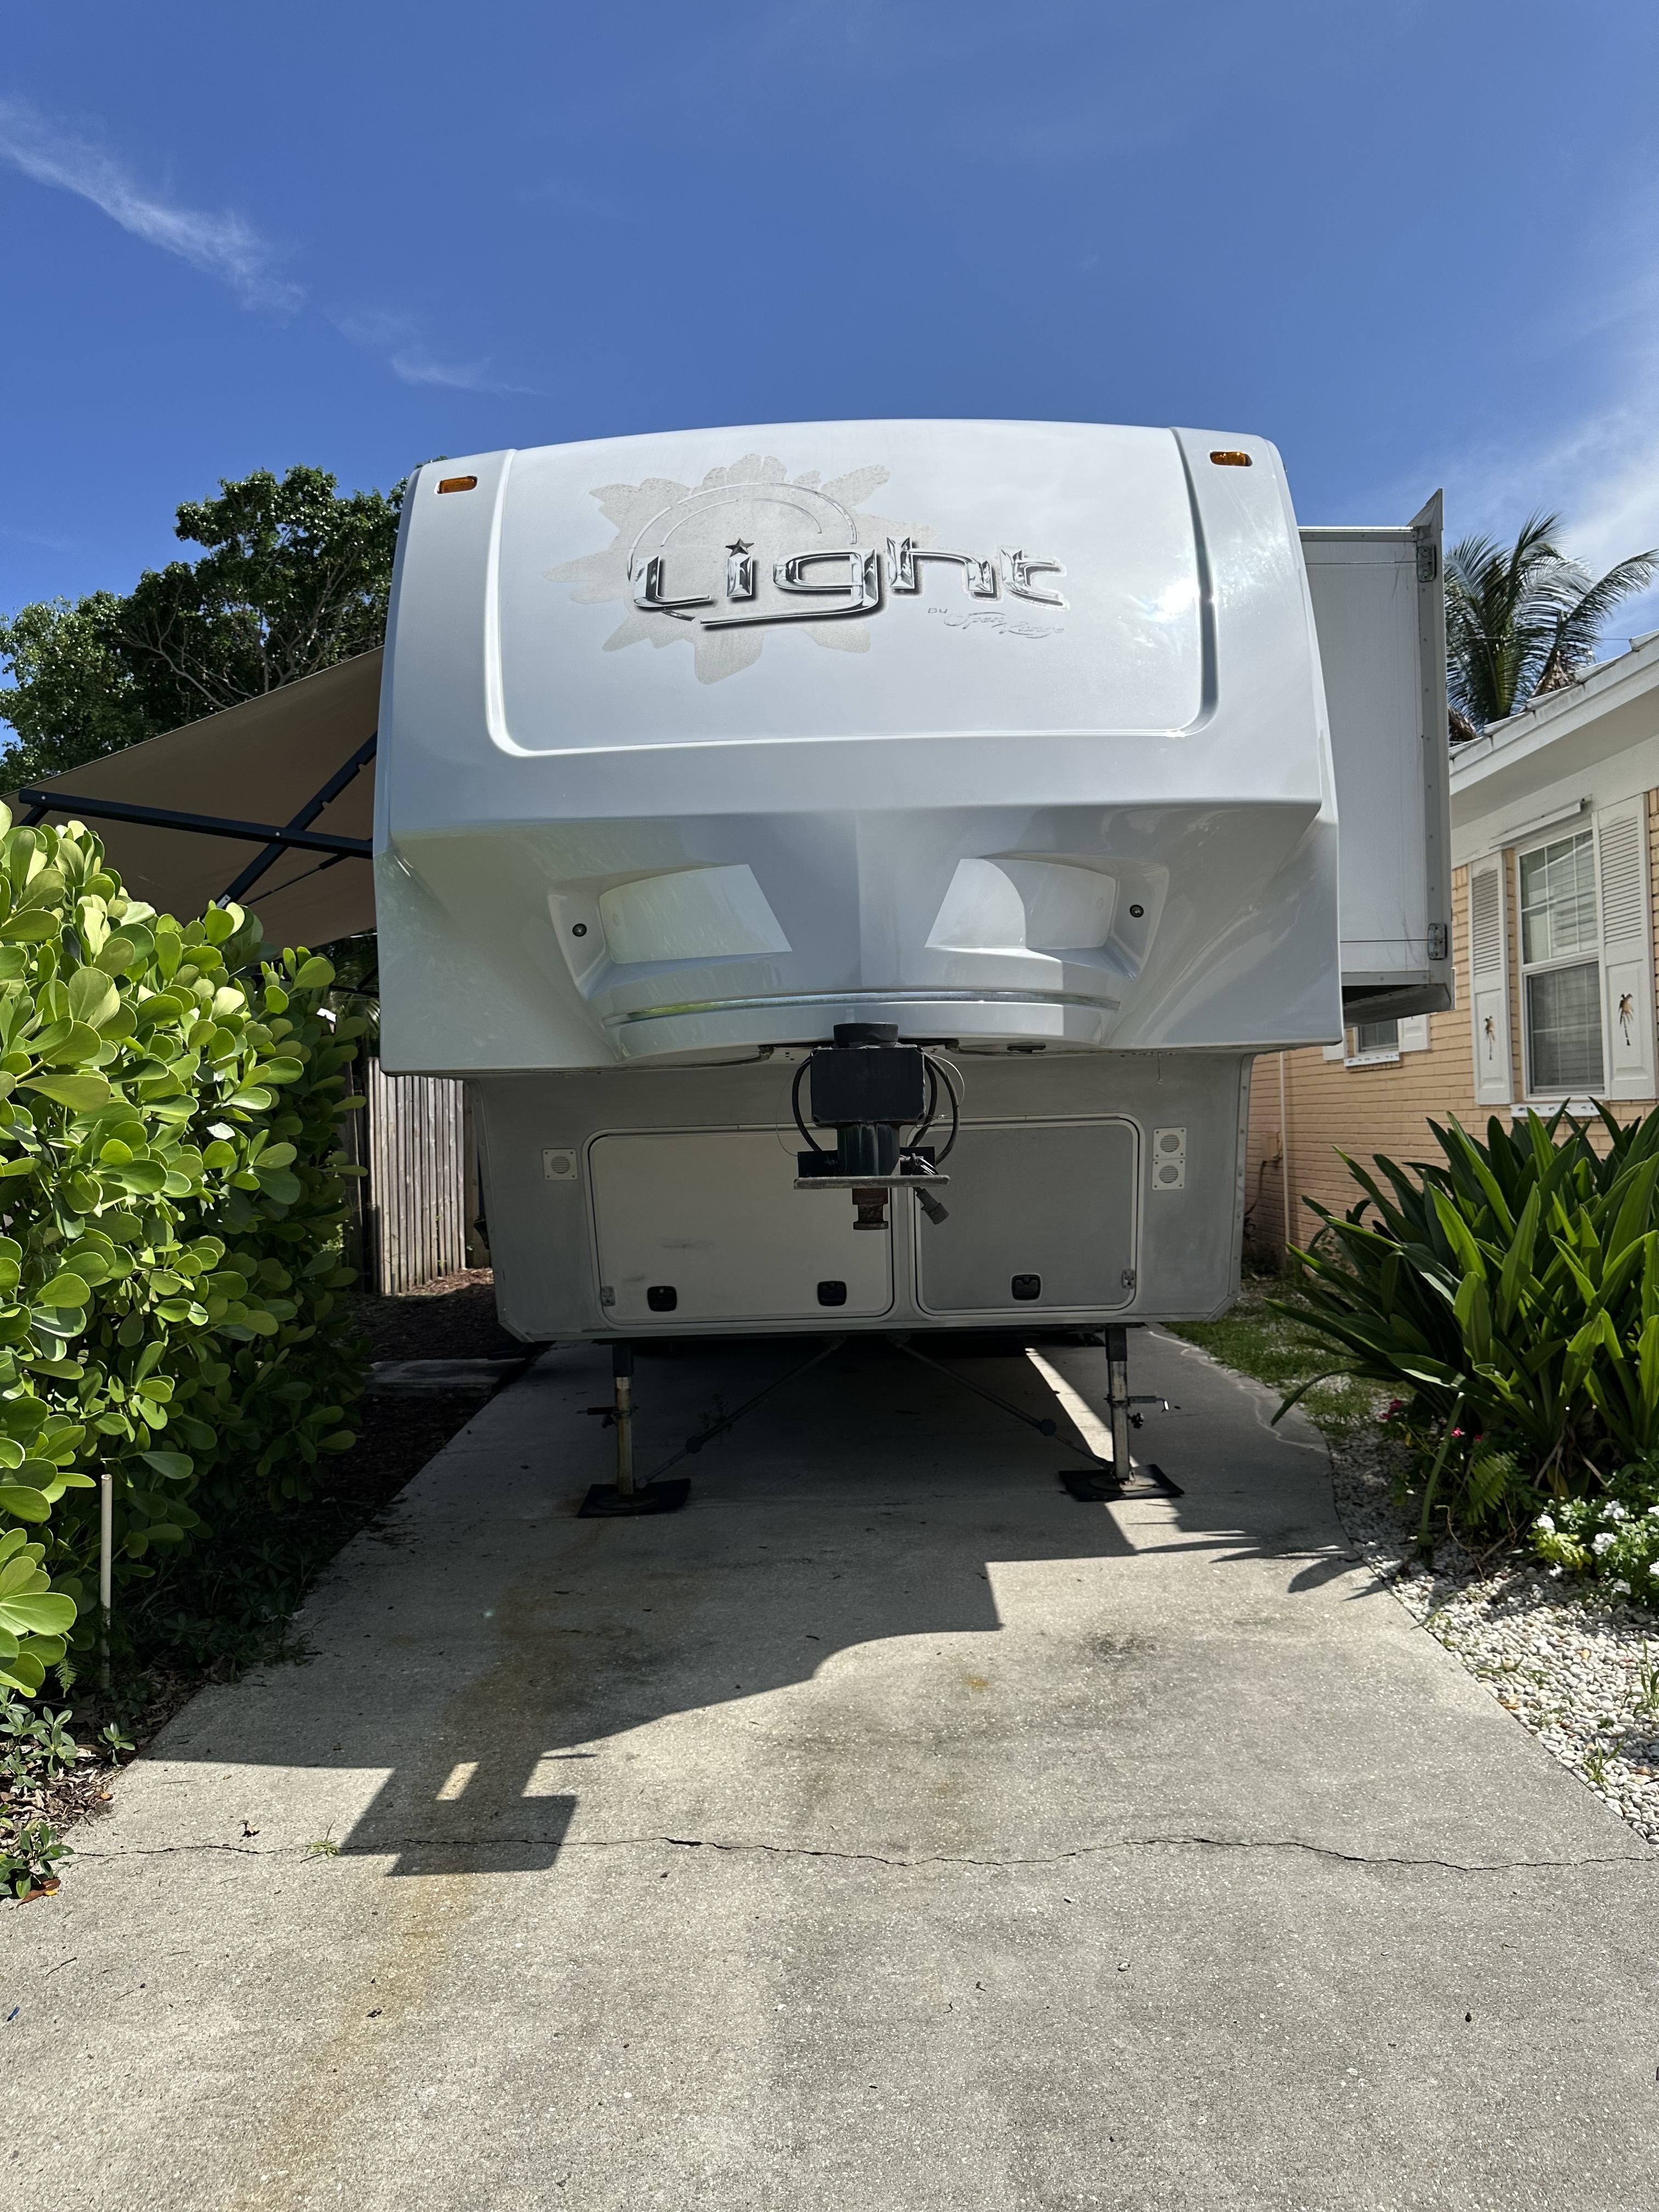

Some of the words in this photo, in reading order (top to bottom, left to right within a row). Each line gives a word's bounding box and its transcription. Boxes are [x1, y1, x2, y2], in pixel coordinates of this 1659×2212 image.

[634, 536, 1065, 628] Light
[943, 612, 1006, 630] Open
[992, 621, 1065, 639] Range
